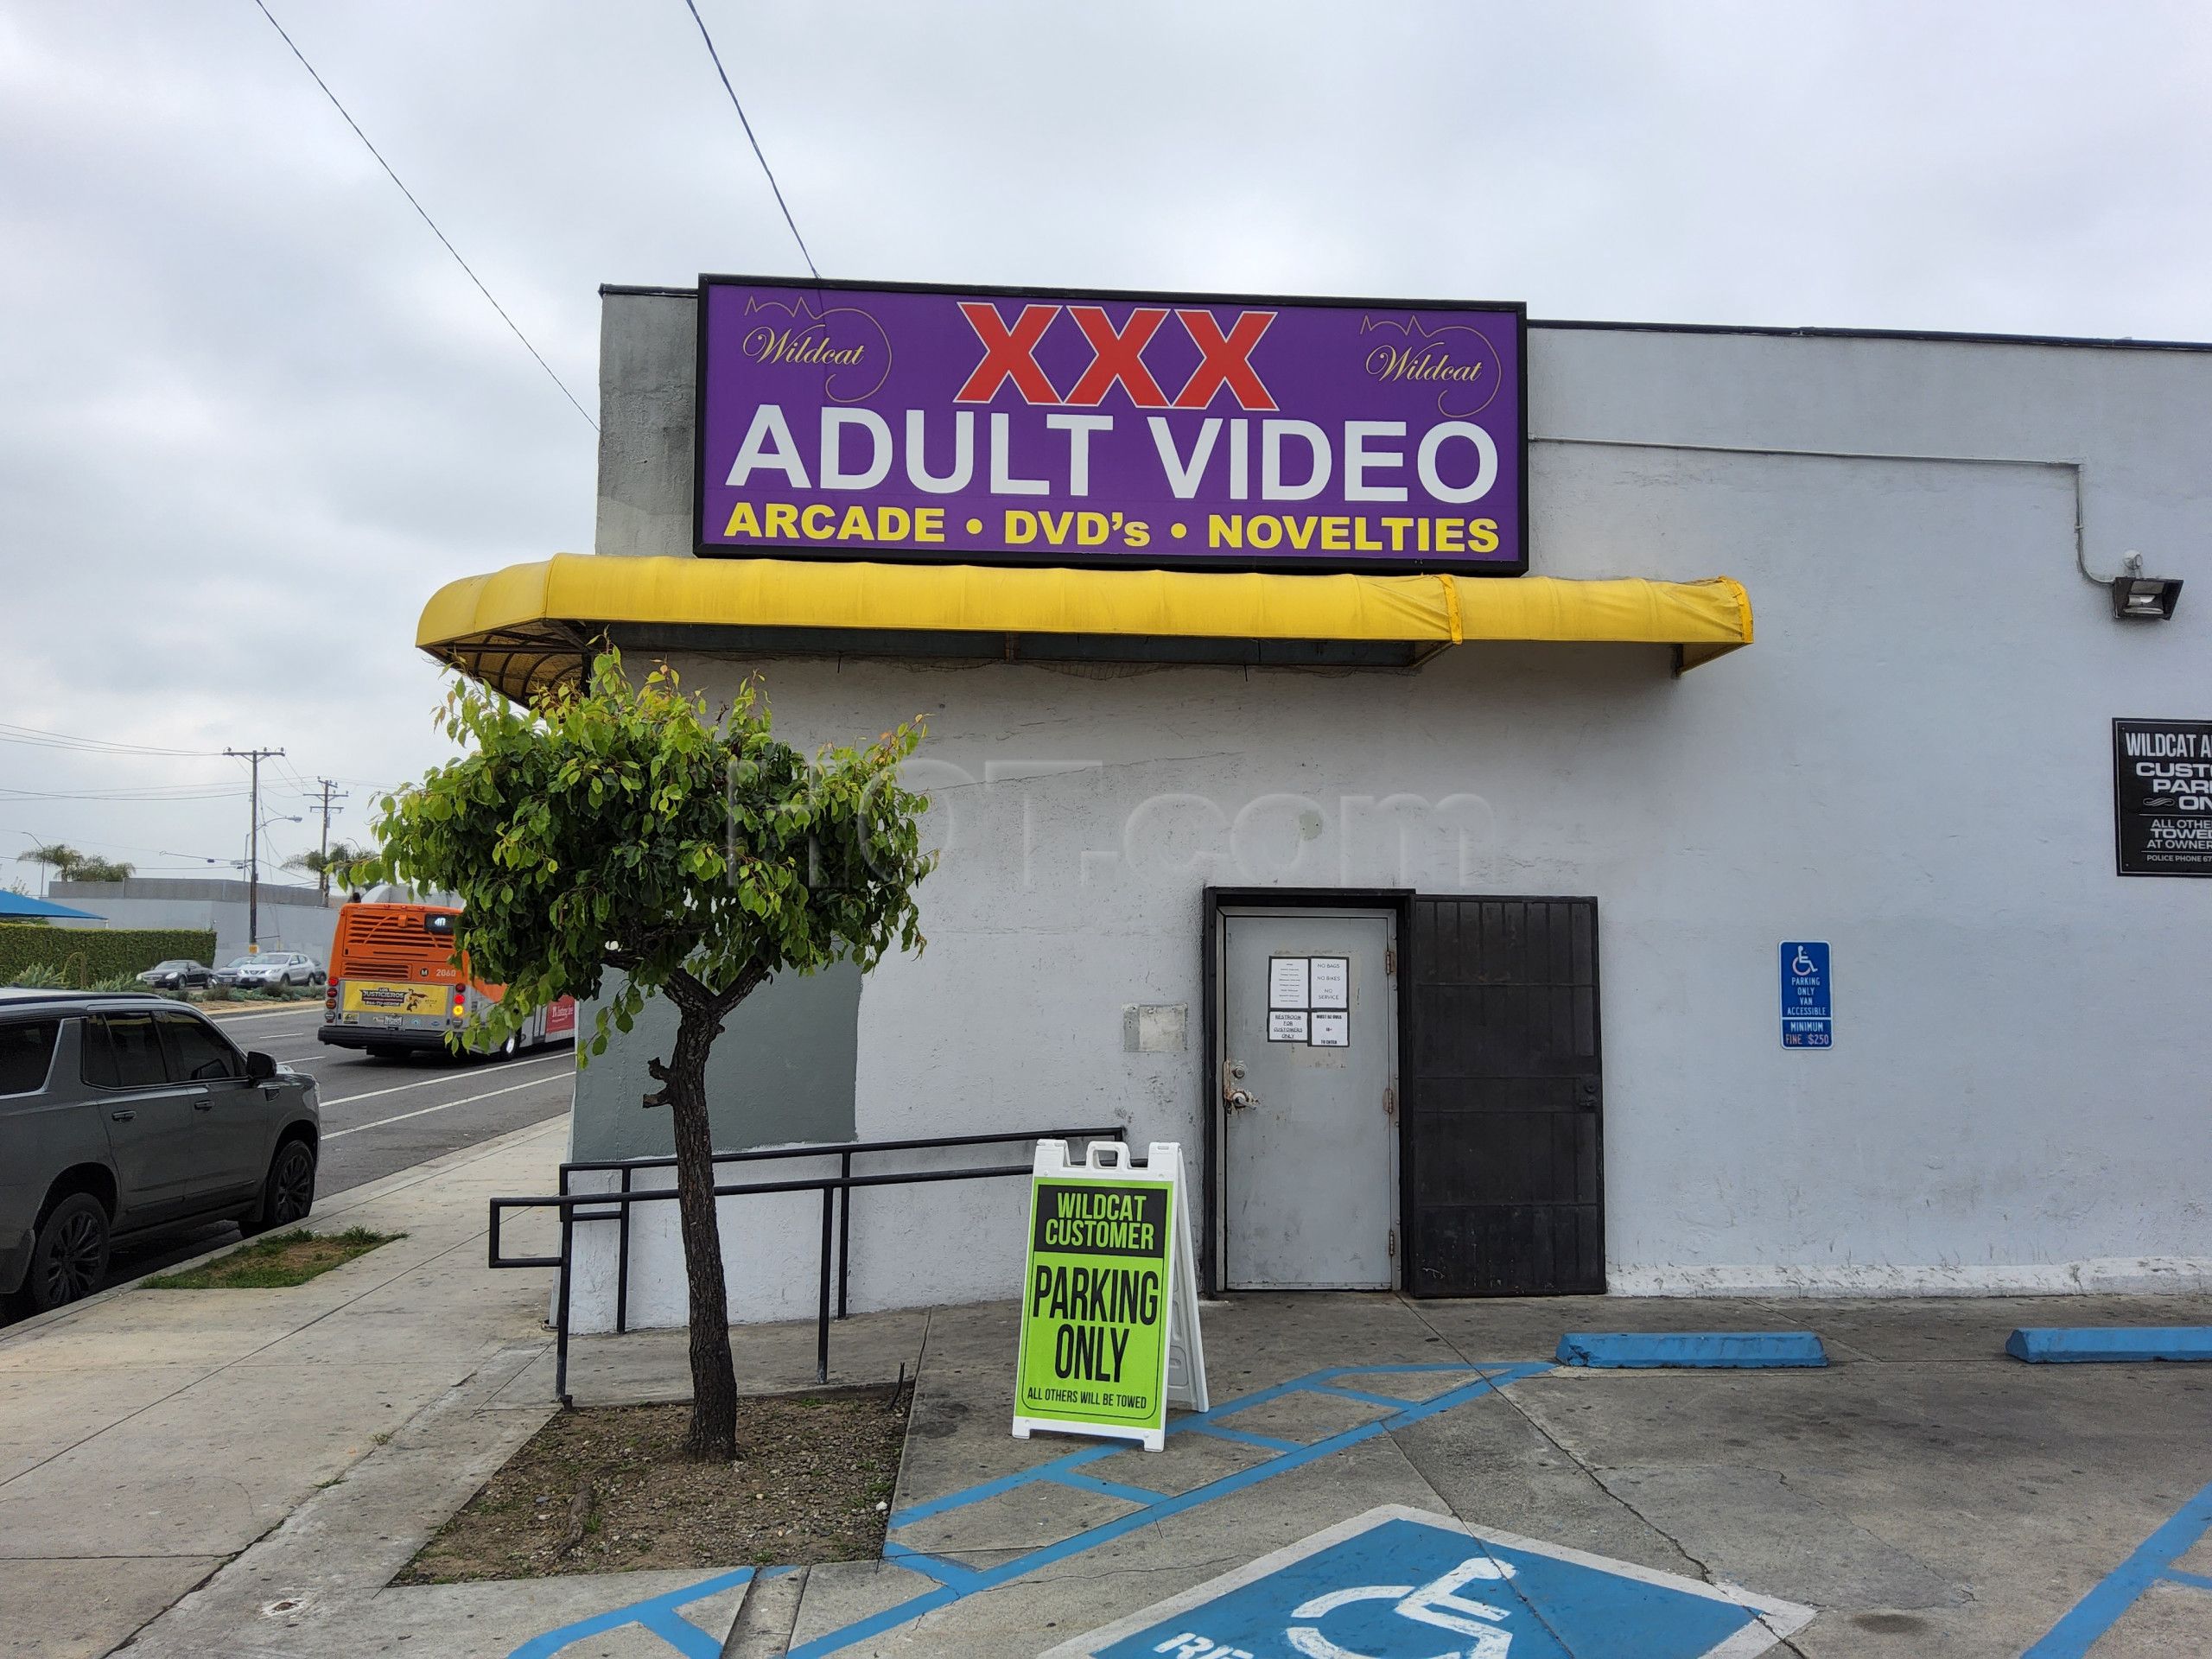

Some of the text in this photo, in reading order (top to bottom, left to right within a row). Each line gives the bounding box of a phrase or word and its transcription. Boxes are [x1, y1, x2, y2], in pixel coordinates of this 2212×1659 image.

[743, 324, 864, 365] Wildcat
[952, 302, 1281, 412] XXX
[1366, 342, 1482, 381] Wildcat
[725, 404, 1499, 505] ADULT VIDEO
[723, 501, 1499, 552] ARCADE DVD's NOVELTIES
[2126, 733, 2212, 758] WILDCAT A
[2136, 762, 2212, 778] CUST
[2152, 779, 2212, 793] PAR
[2152, 819, 2212, 830] ALL OTHE
[2146, 839, 2163, 849] AT
[436, 969, 456, 977] 2060
[1791, 976, 1821, 985] PARKING
[1797, 987, 1815, 995] ONLY
[1787, 1007, 1826, 1015] ACCESSIBLE
[1790, 1021, 1823, 1032] MINIMUM
[1785, 1033, 1829, 1045] FINE $250
[1057, 1192, 1147, 1222] WILDCAT
[1046, 1219, 1154, 1250] CUSTOMER
[1033, 1265, 1159, 1325] PARKING
[1055, 1324, 1129, 1382] ONLY
[1027, 1387, 1147, 1408] ALL OTHERS WILL BE TOWED
